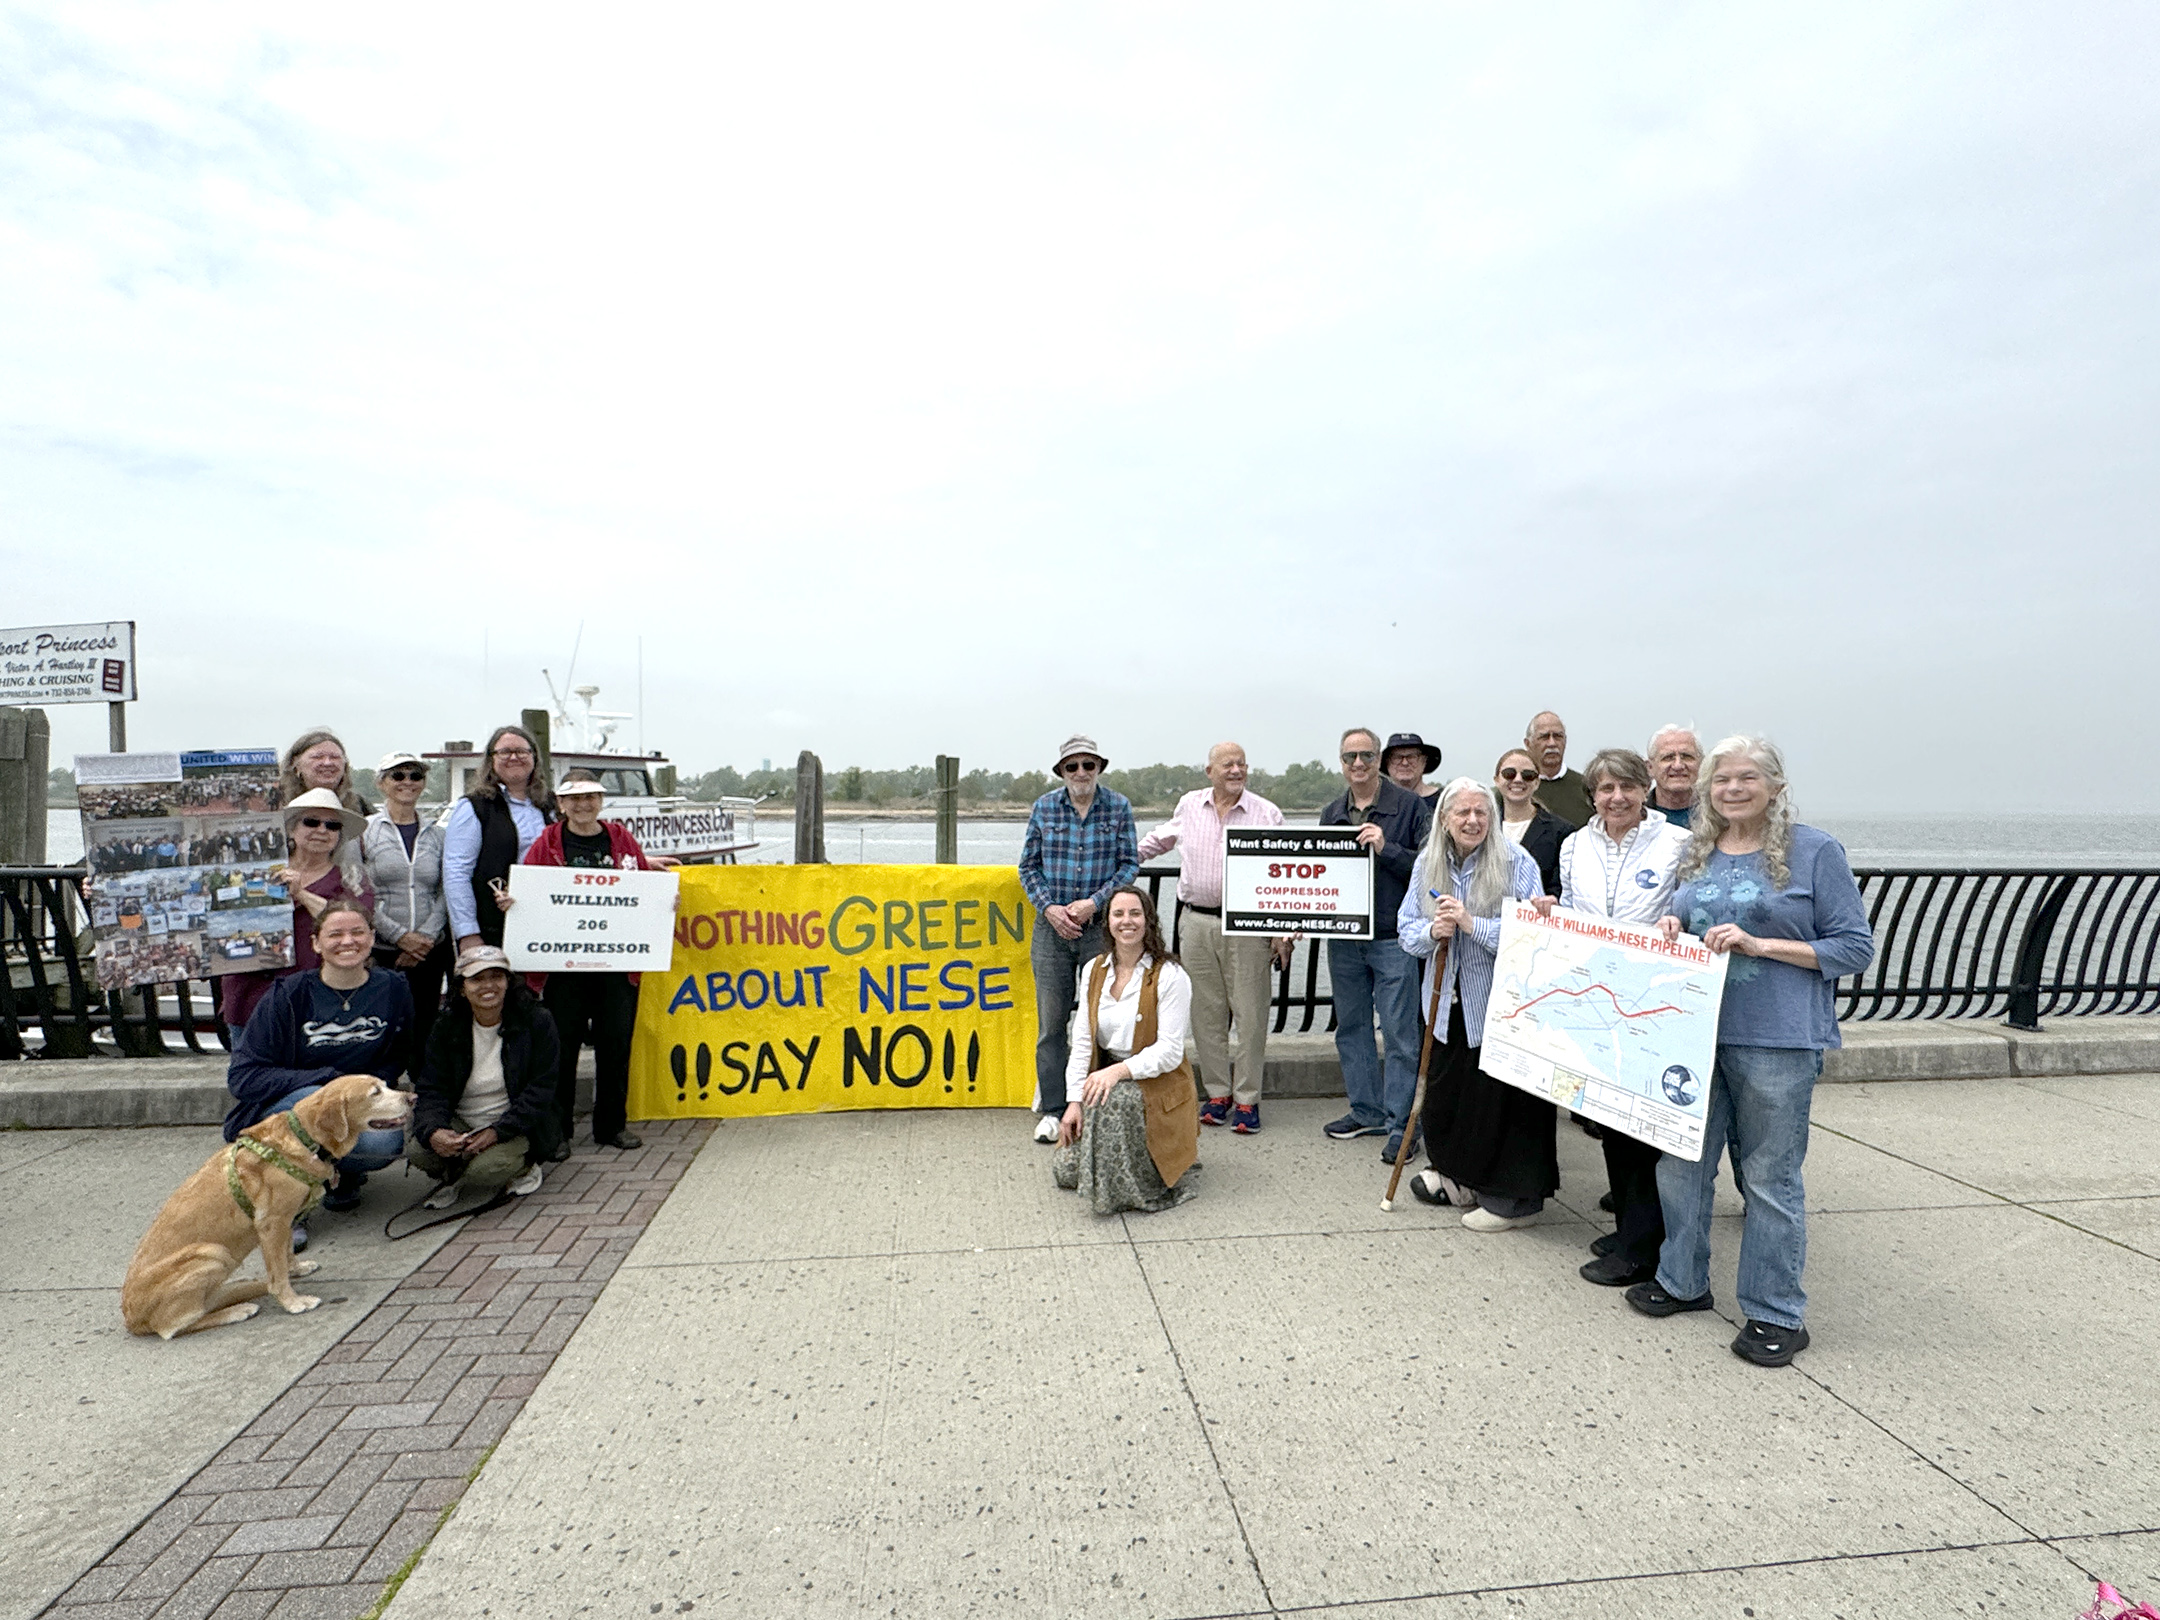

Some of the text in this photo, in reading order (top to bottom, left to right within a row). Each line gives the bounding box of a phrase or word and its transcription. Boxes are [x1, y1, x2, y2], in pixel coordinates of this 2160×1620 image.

[35, 633, 118, 656] Princess
[27, 676, 36, 686] &
[39, 673, 94, 686] CRUISING
[181, 752, 276, 764] UNITED WE WIN
[687, 833, 734, 845] WATCHING
[1229, 838, 1260, 849] Want
[1262, 838, 1300, 851] Safety
[1303, 839, 1313, 850] &
[1316, 839, 1357, 851] Health
[1268, 863, 1327, 879] STOP
[573, 873, 620, 886] STOP
[1255, 886, 1340, 897] COMPRESSOR
[550, 894, 639, 907] WILLIAMS
[1258, 901, 1337, 911] STATION 206
[577, 919, 608, 930] 206
[673, 895, 1024, 956] NOTHING GREEN
[1233, 918, 1361, 933] www.Scrap-NESE.org
[1516, 907, 1542, 924] STOP
[1563, 918, 1648, 949] WILLIAMS-NESE
[1651, 937, 1711, 964] PIPELINE!
[527, 941, 651, 954] COMPRESSOR
[667, 960, 1013, 1015] ABOUT NESE
